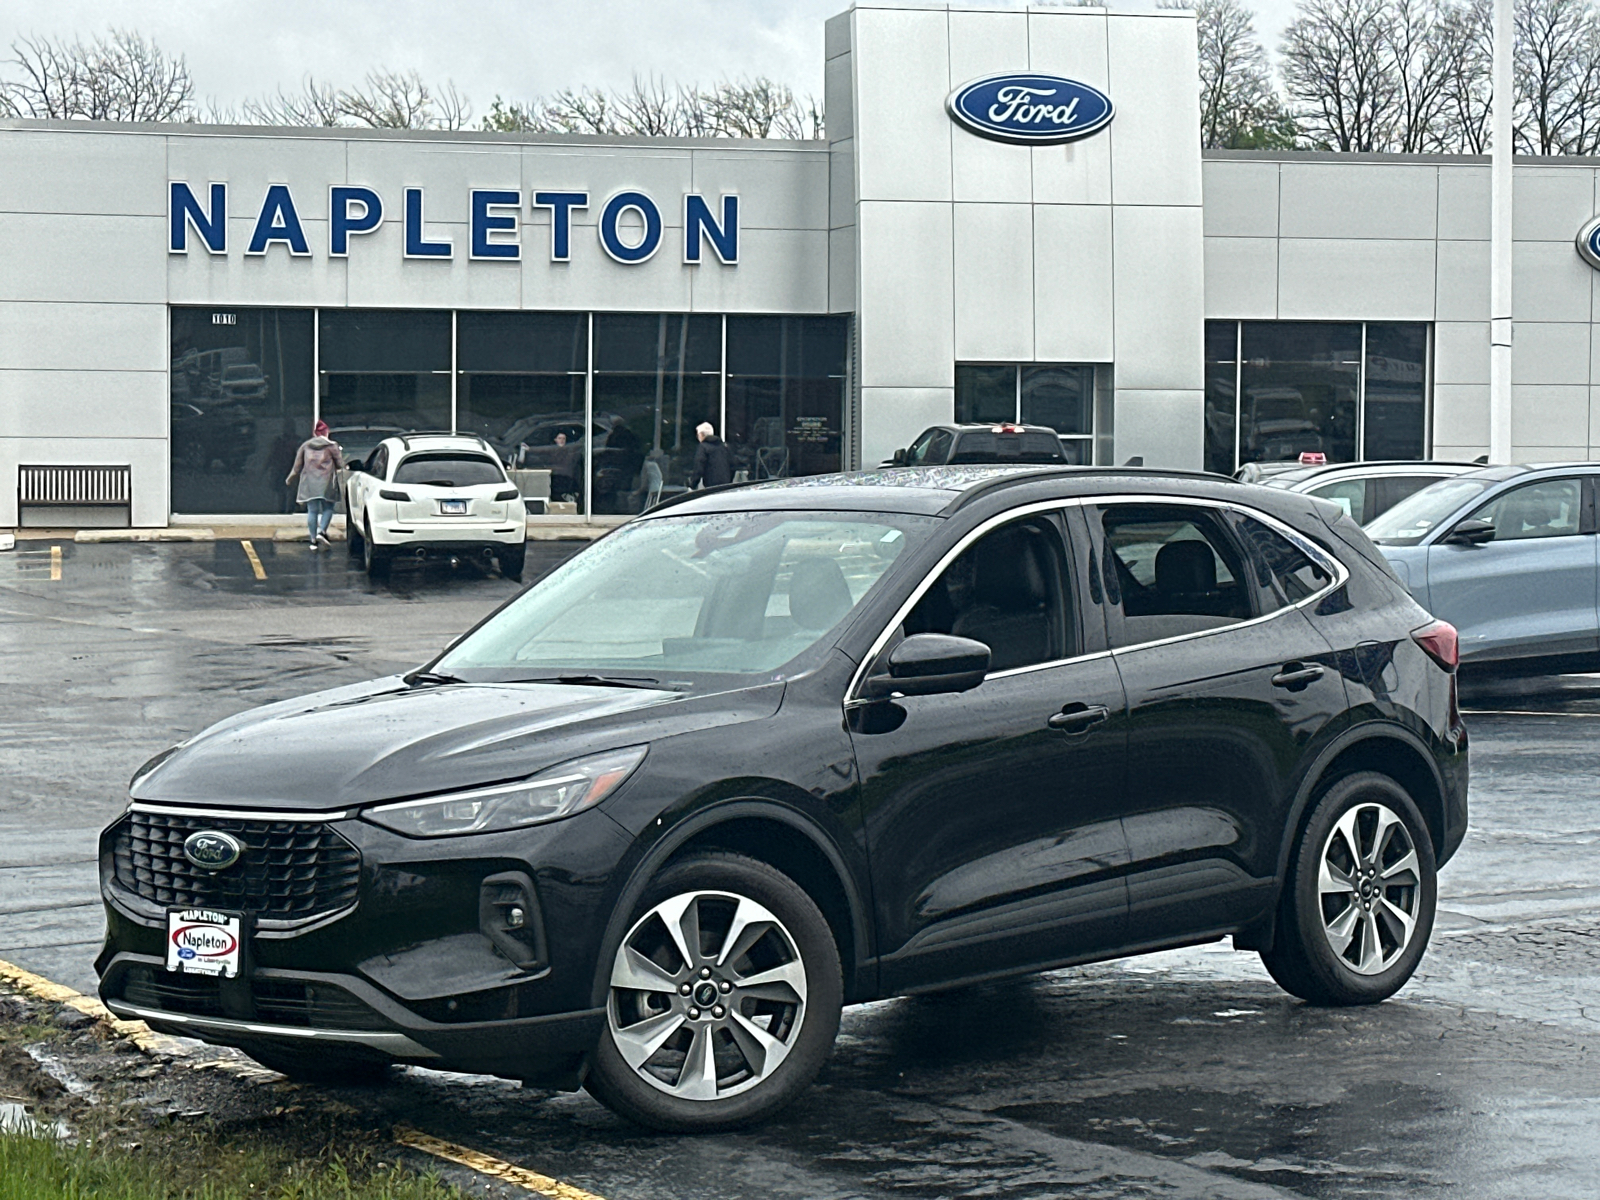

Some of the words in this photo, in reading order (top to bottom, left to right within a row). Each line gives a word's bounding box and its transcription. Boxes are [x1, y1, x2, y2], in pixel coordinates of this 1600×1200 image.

[988, 85, 1080, 125] Ford
[167, 180, 739, 265] NAPLETON
[213, 314, 236, 325] 1010
[194, 838, 225, 860] Ford
[183, 930, 227, 951] Napleton
